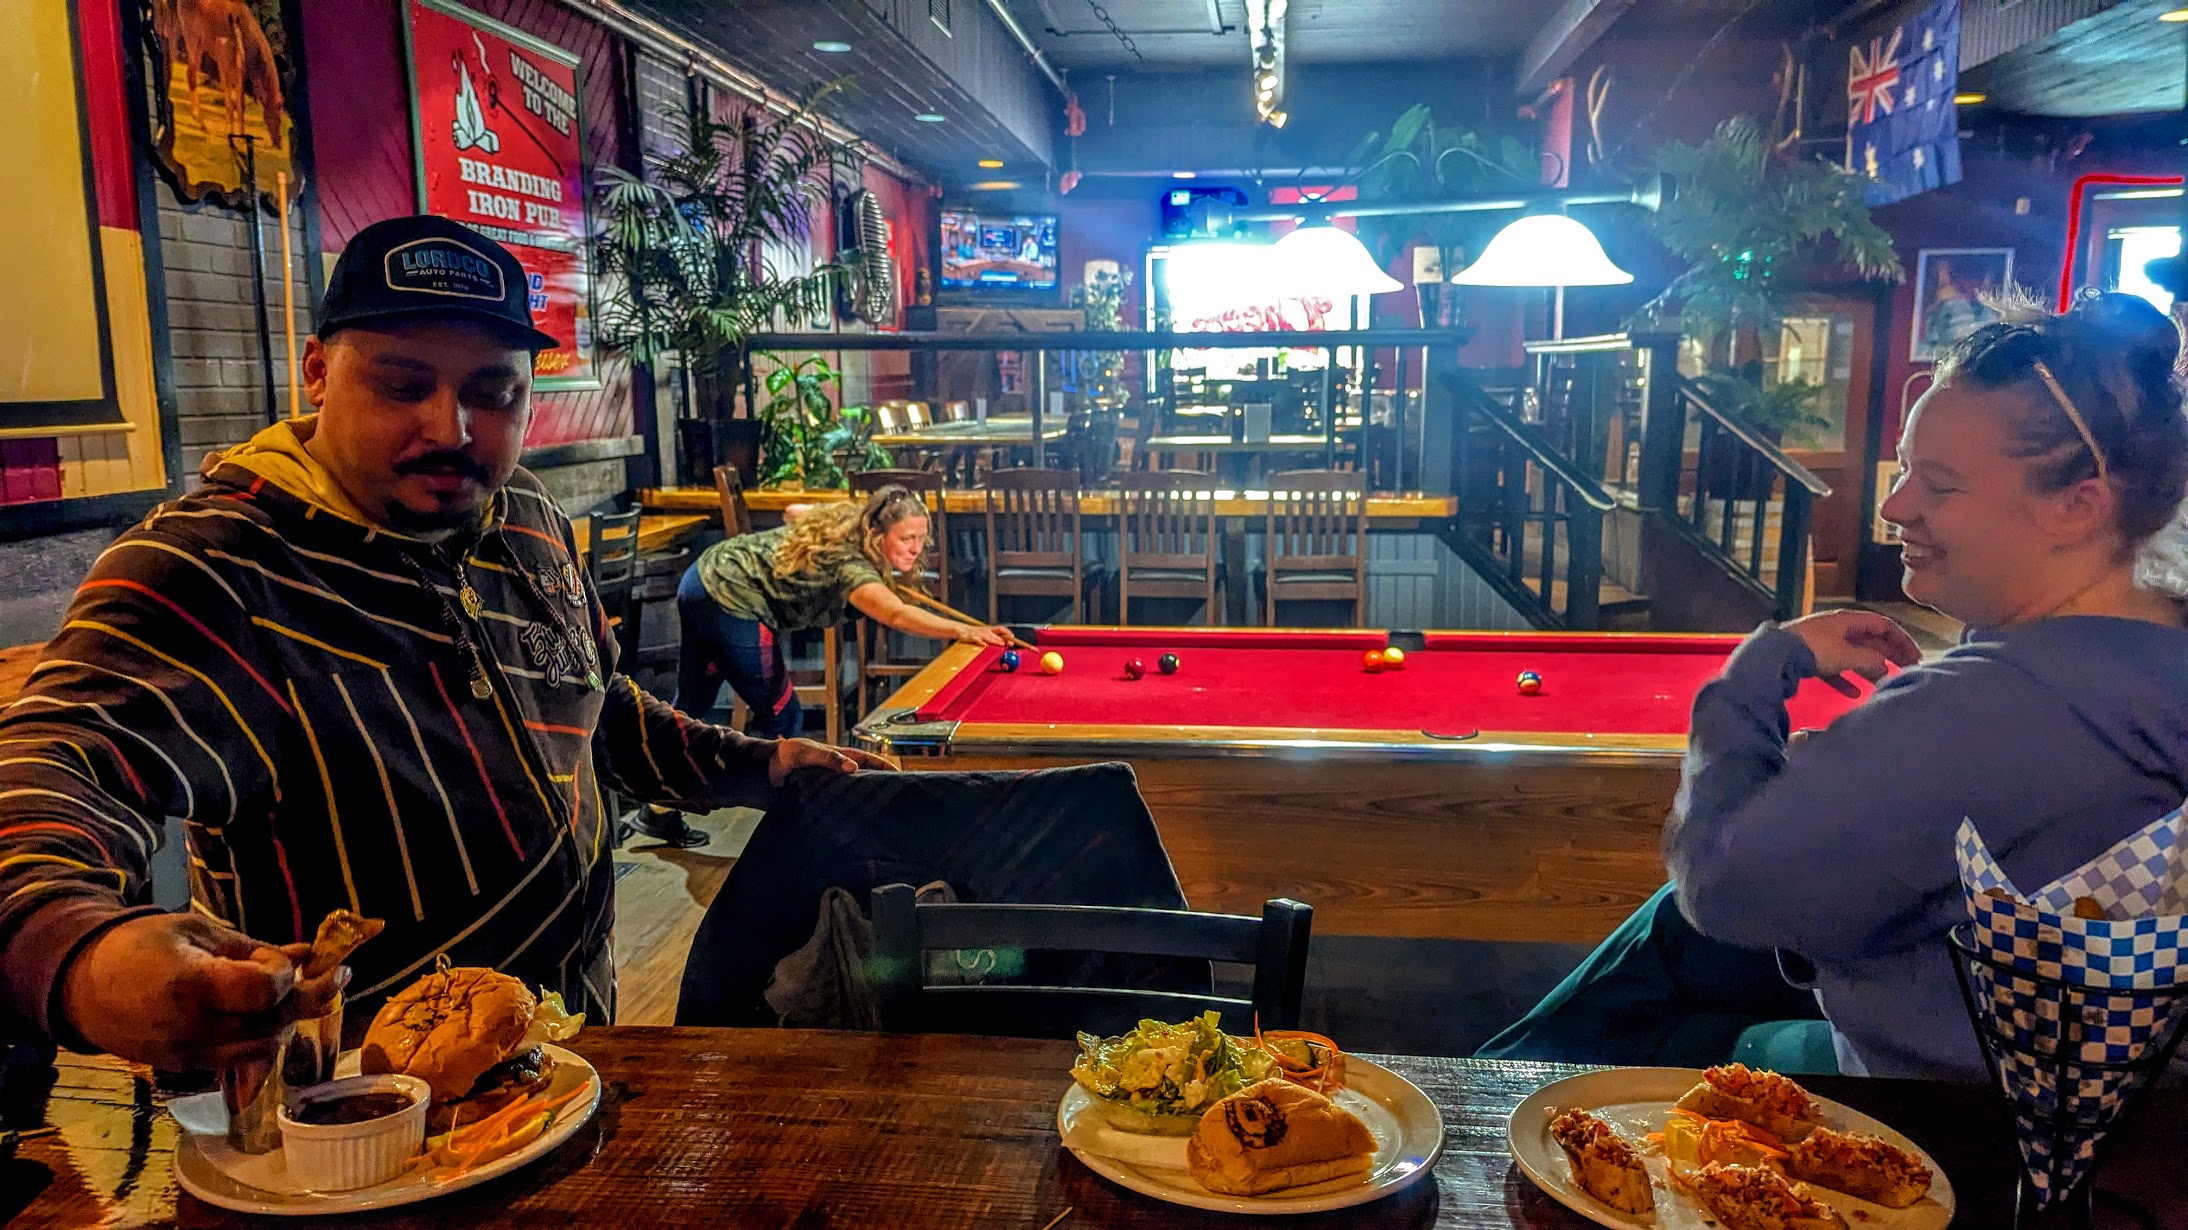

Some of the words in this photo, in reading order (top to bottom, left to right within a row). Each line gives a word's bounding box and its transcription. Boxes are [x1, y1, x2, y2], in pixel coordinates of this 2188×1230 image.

[510, 52, 577, 120] WELCOME
[523, 85, 542, 116] TO
[544, 102, 570, 137] THE
[458, 157, 562, 202] BRANDING
[467, 190, 521, 222] IRON
[525, 201, 562, 229] PUB
[402, 249, 490, 279] LORDCO
[418, 268, 446, 277] AUTO
[449, 269, 479, 282] PARTS
[432, 281, 449, 289] EST.
